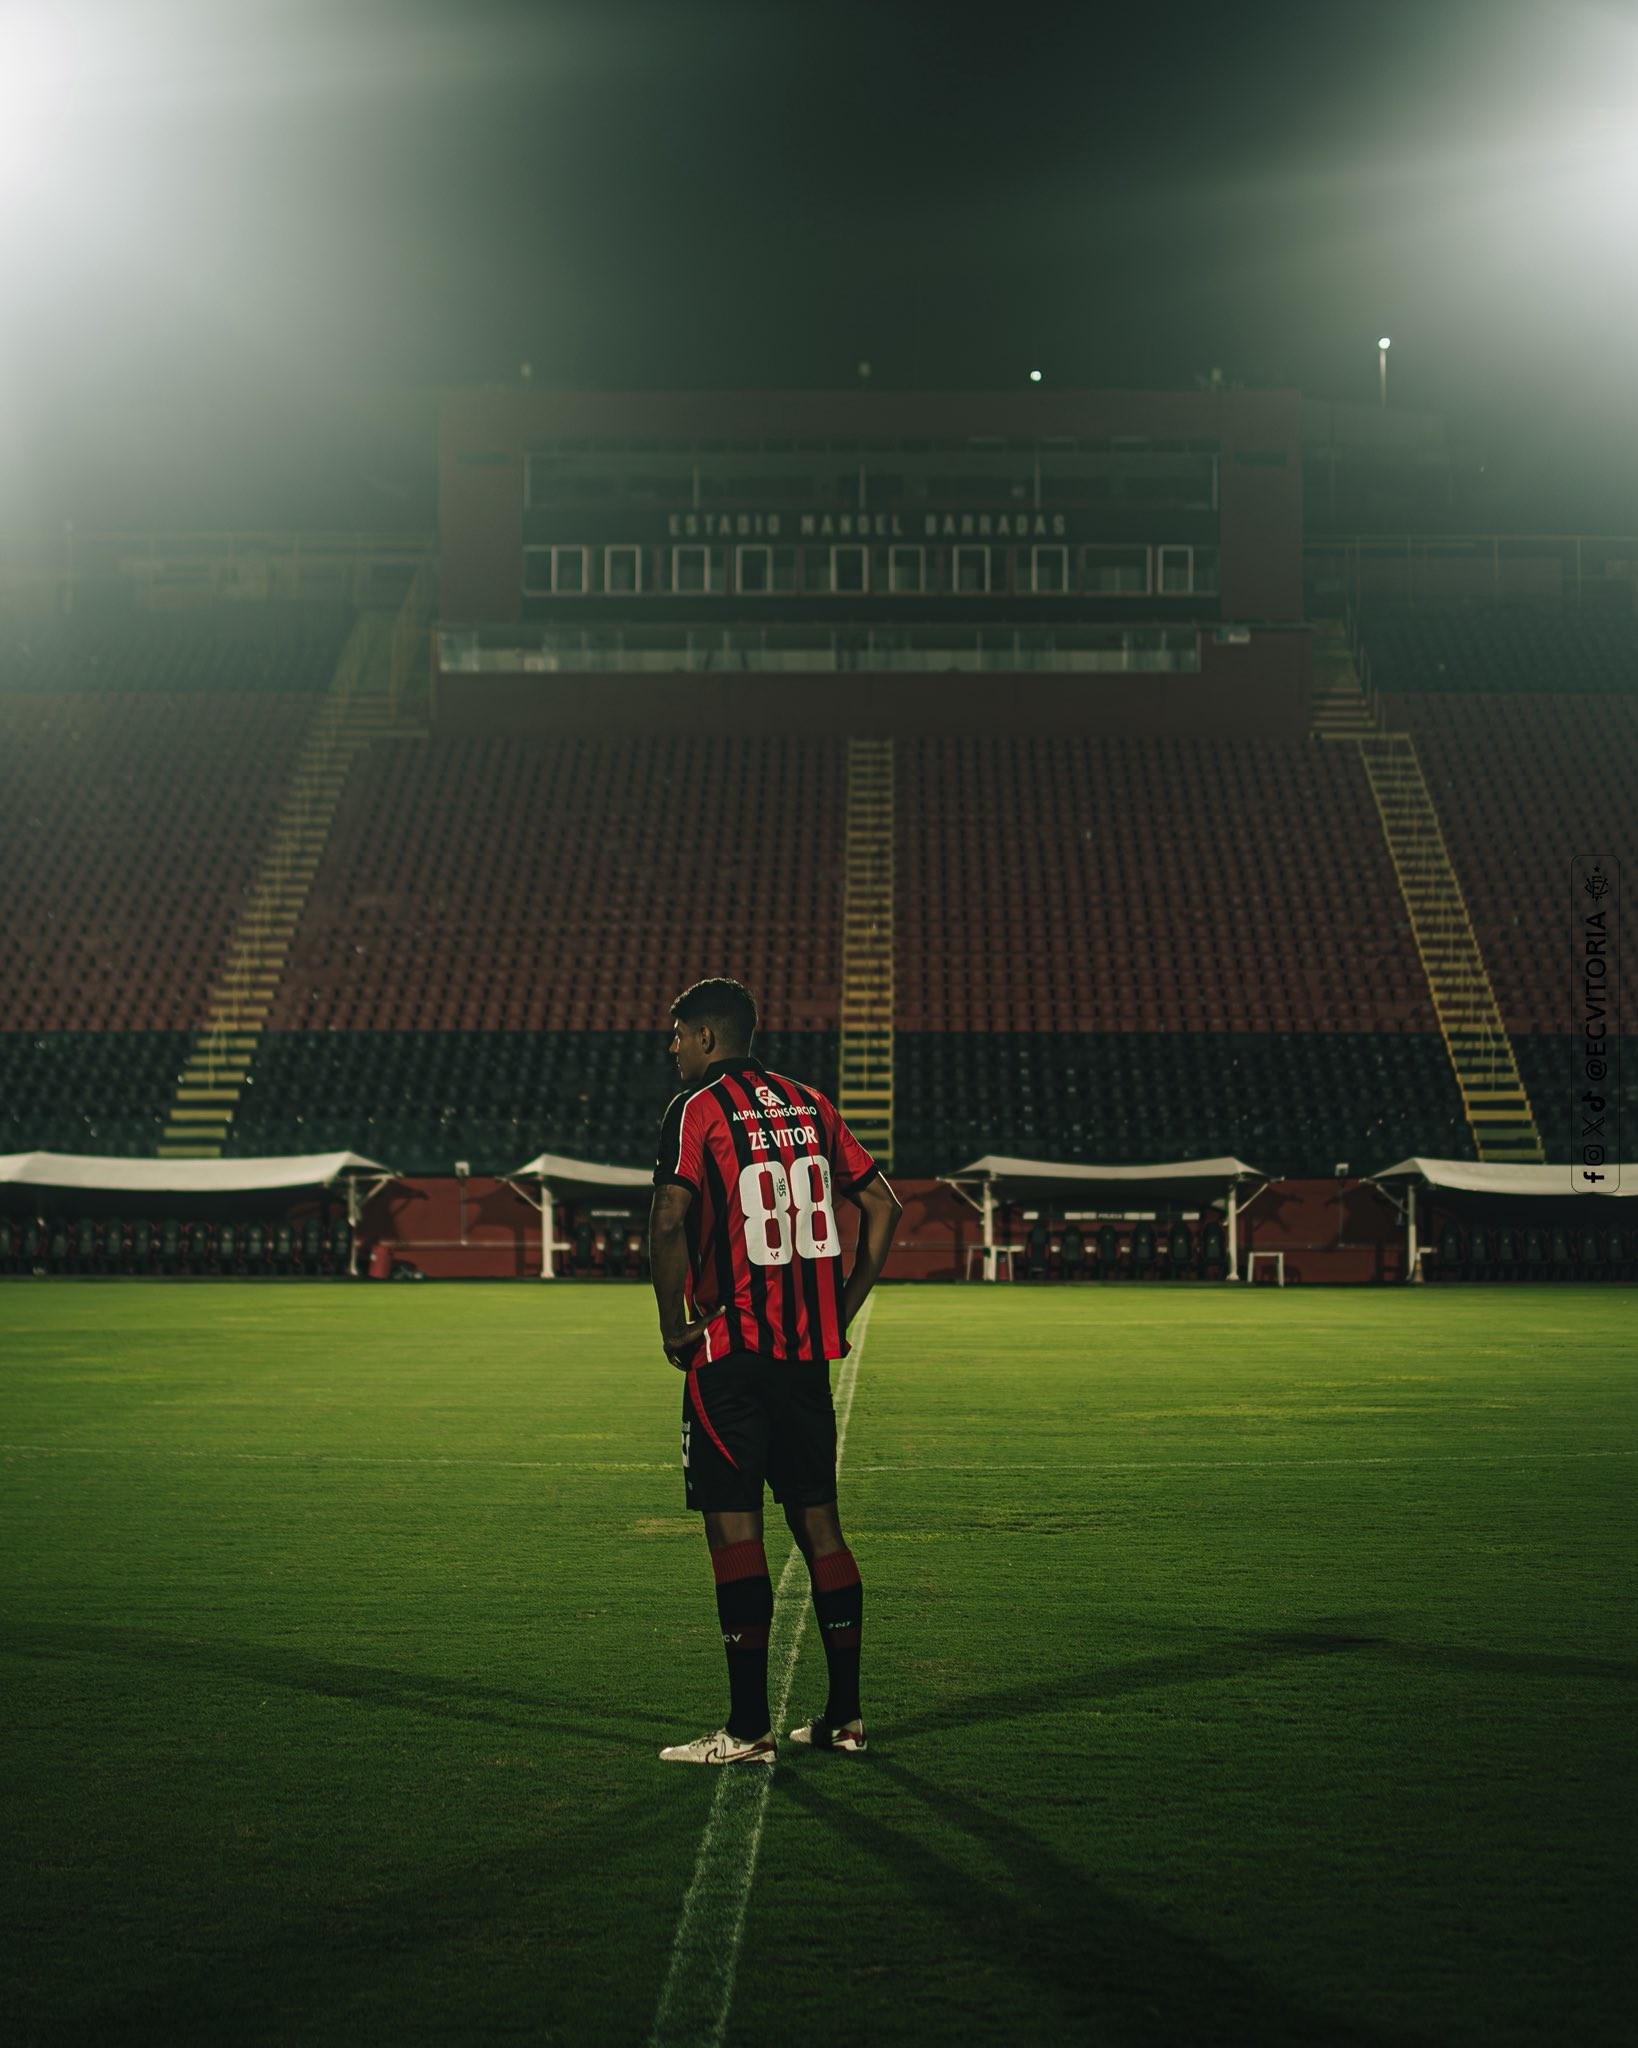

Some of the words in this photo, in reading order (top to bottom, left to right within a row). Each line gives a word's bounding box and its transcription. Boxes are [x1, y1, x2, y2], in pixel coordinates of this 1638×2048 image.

[800, 515, 903, 536] MANOEL
[925, 515, 1066, 536] BARRADAS
[732, 1109, 763, 1122] ALPHA
[764, 1105, 818, 1118] CONSÓRCIO
[748, 1128, 770, 1151] ZÉ
[769, 1126, 818, 1148] VITOR
[778, 1178, 787, 1197] SBS
[739, 1155, 841, 1266] 88
